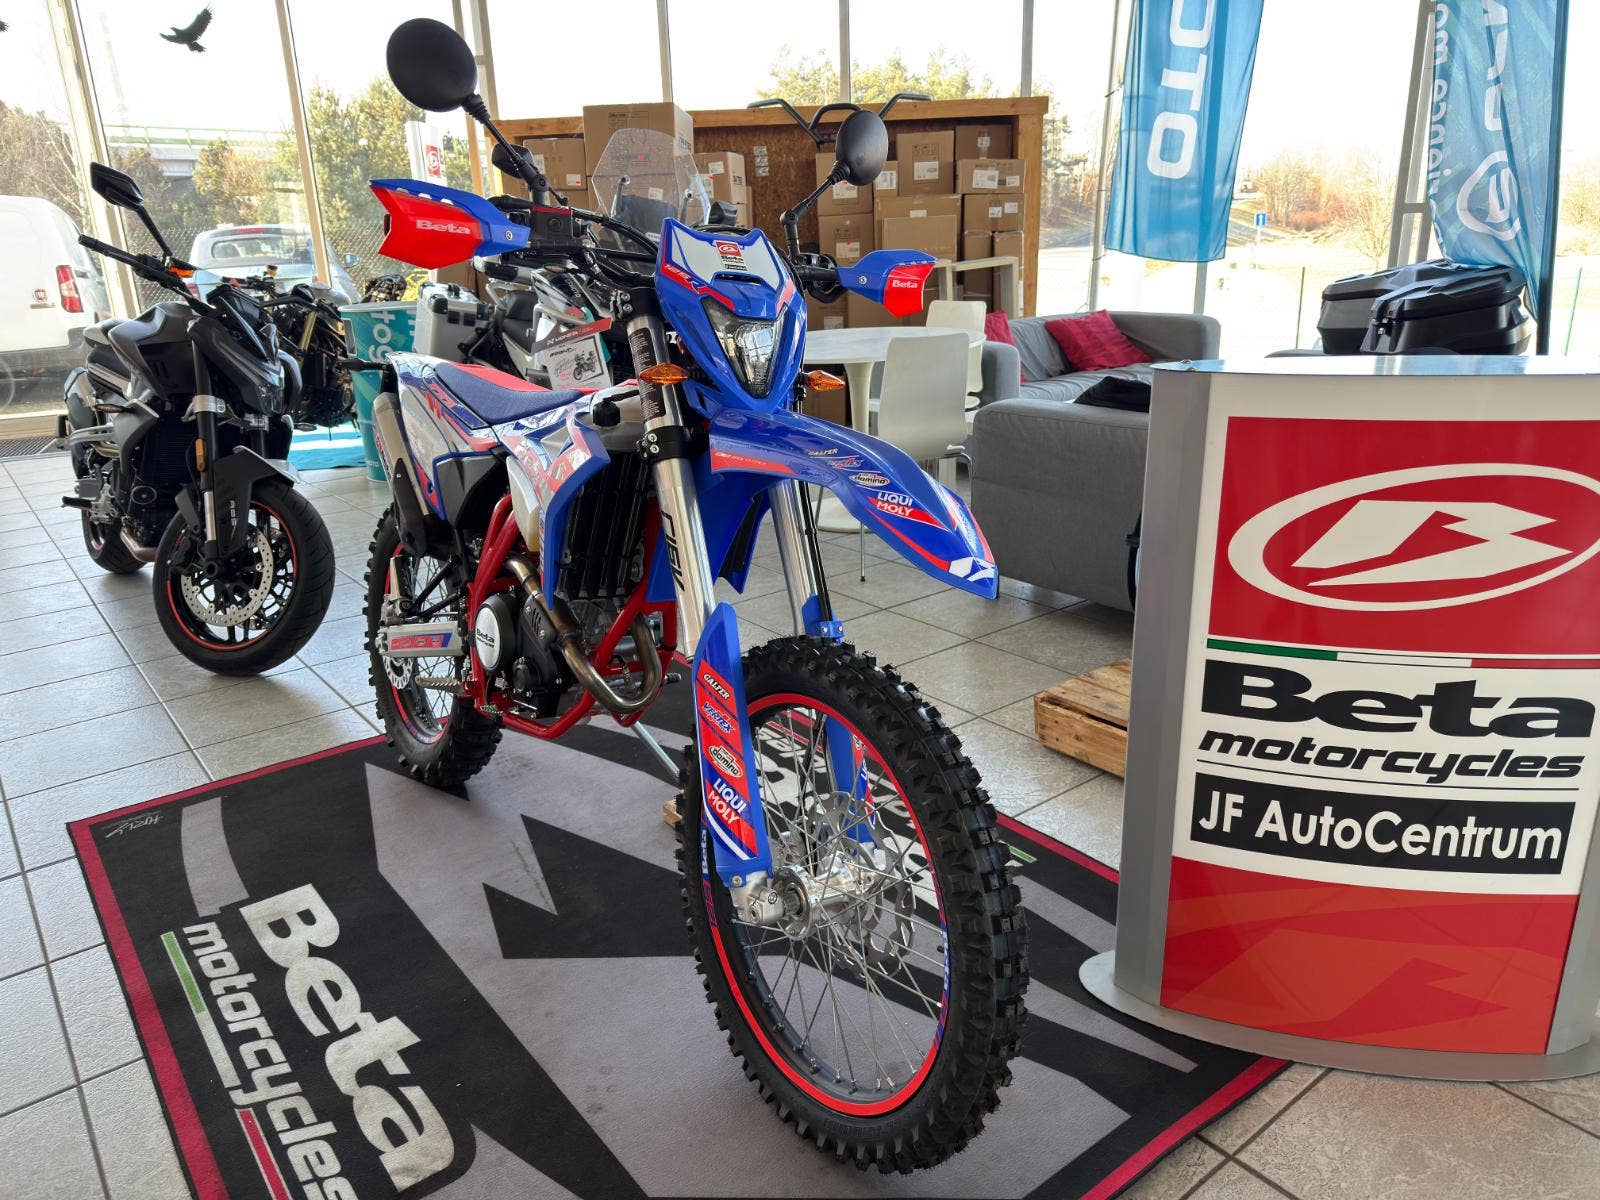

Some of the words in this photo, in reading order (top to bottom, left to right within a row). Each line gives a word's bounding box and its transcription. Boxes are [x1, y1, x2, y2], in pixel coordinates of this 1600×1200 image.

[415, 219, 471, 235] Beta
[892, 280, 918, 289] Beta
[876, 502, 914, 517] MOLY
[877, 492, 914, 507] LIQUI
[703, 672, 731, 701] GALFER
[1200, 658, 1596, 739] Beta
[702, 701, 735, 734] VERTEX
[711, 746, 740, 777] domino
[1198, 729, 1586, 785] motorcycles
[707, 789, 741, 825] MOLY
[713, 777, 747, 815] LIQUI
[1198, 790, 1245, 834] JF
[1253, 798, 1564, 861] AutoCentrum
[238, 883, 455, 1194] Beta
